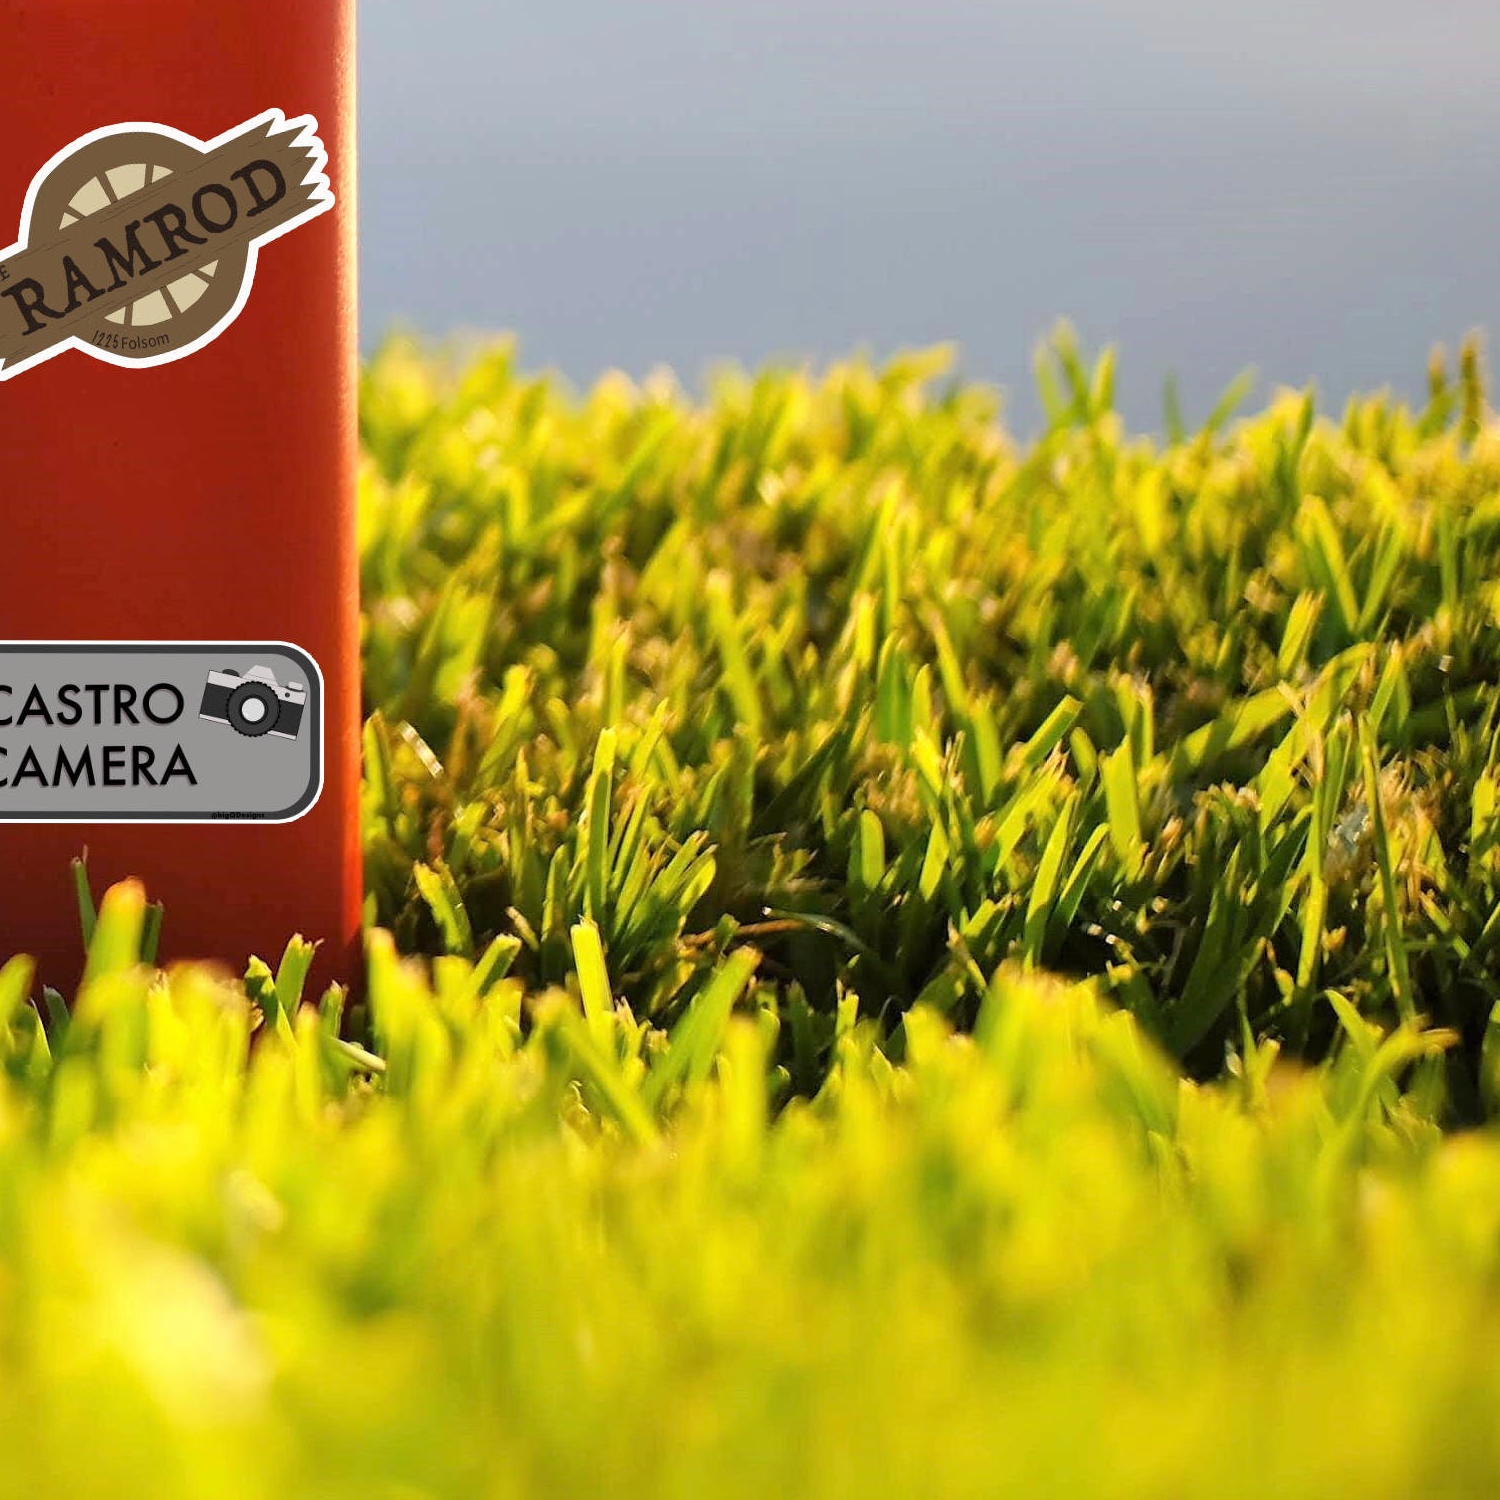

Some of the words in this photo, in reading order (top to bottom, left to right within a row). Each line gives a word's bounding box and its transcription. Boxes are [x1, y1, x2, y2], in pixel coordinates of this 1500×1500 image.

[0, 159, 287, 337] RAMROD
[91, 329, 119, 349] 1225
[121, 333, 170, 350] Folsom
